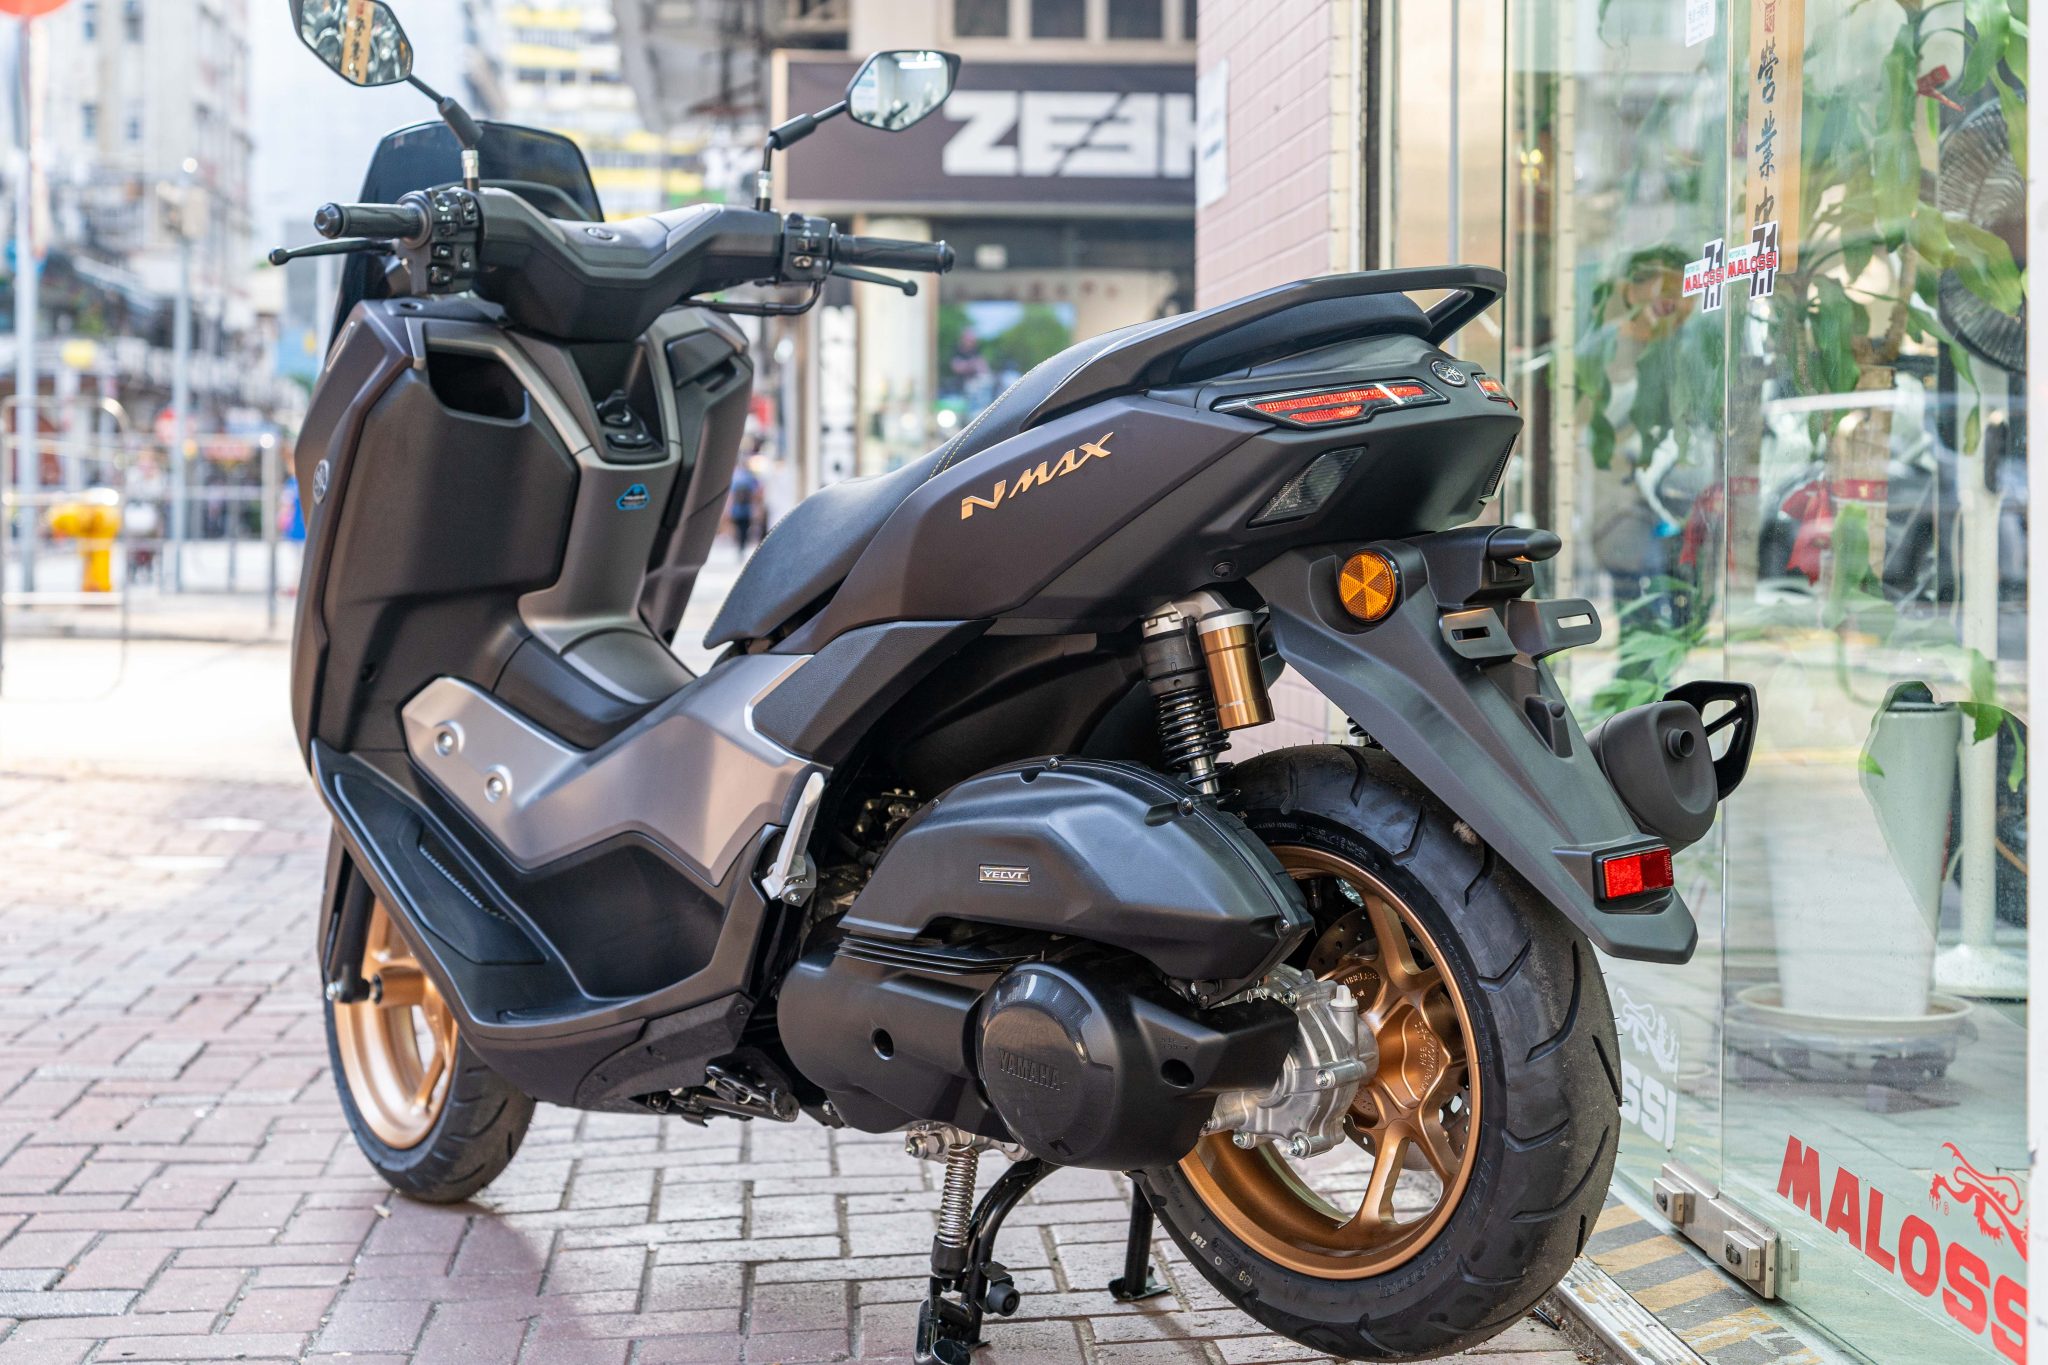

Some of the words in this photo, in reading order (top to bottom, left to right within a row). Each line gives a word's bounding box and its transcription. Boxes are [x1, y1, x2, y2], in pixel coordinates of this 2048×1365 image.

[1684, 266, 1724, 293] MALOSSI
[1727, 251, 1777, 278] MALOSSI
[999, 1048, 1062, 1092] YAMAHA
[1776, 1134, 2027, 1365] MALOSS
